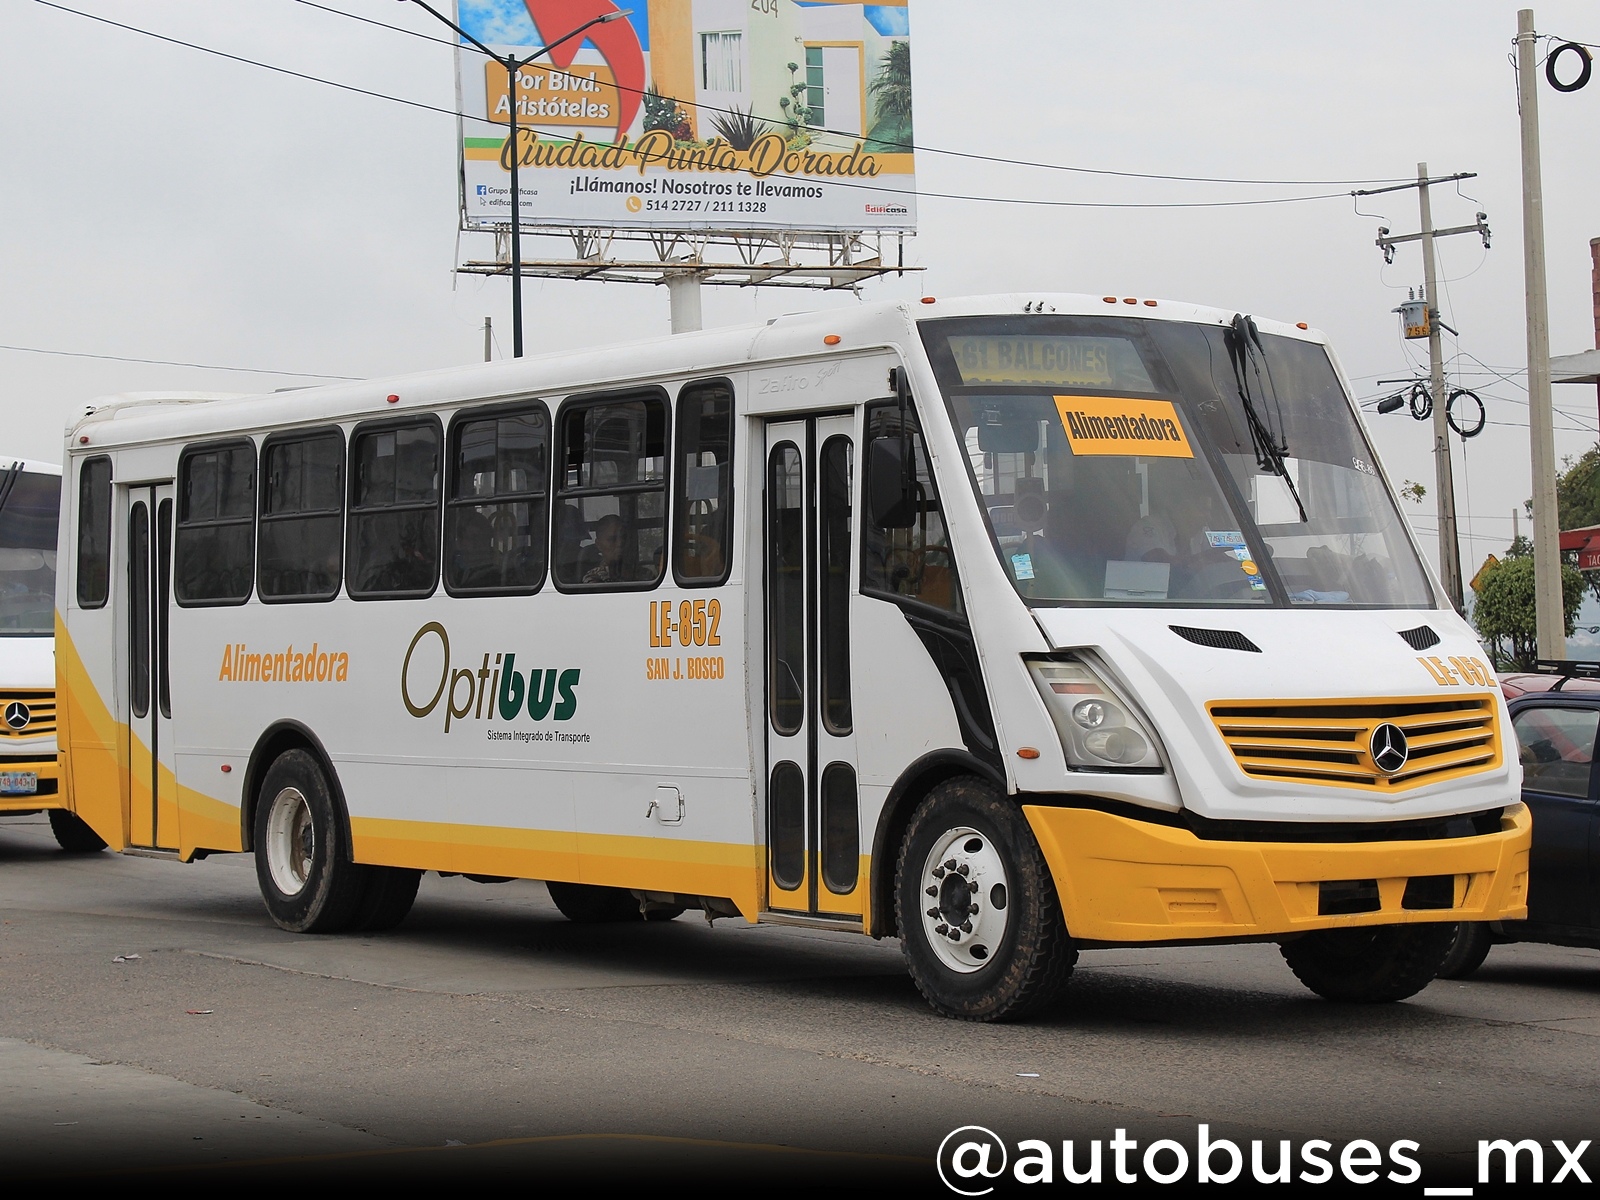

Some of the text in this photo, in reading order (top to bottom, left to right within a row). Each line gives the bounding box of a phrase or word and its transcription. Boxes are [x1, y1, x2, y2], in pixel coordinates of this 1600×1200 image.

[507, 70, 601, 92] Por Blvd.
[494, 94, 609, 118] Aristóteles
[500, 127, 882, 176] Ciudad Punta Dorada
[488, 187, 508, 195] Grupo
[570, 176, 822, 198] ¡Llámanos! Nosotros te llevamos
[646, 200, 766, 212] 514 2727 / 211 1328
[865, 204, 907, 213] Edificasa
[998, 341, 1106, 373] BALCONES
[758, 374, 809, 394] Zafiro
[1066, 411, 1180, 441] Alimentadora
[649, 598, 721, 648] LE-852
[219, 643, 349, 682] Alimentadora
[647, 657, 724, 680] SAN J. BOSCO
[1416, 656, 1497, 687] LE-852
[402, 621, 581, 734] Optibus
[487, 729, 591, 745] Sistema Integrado de Transporte
